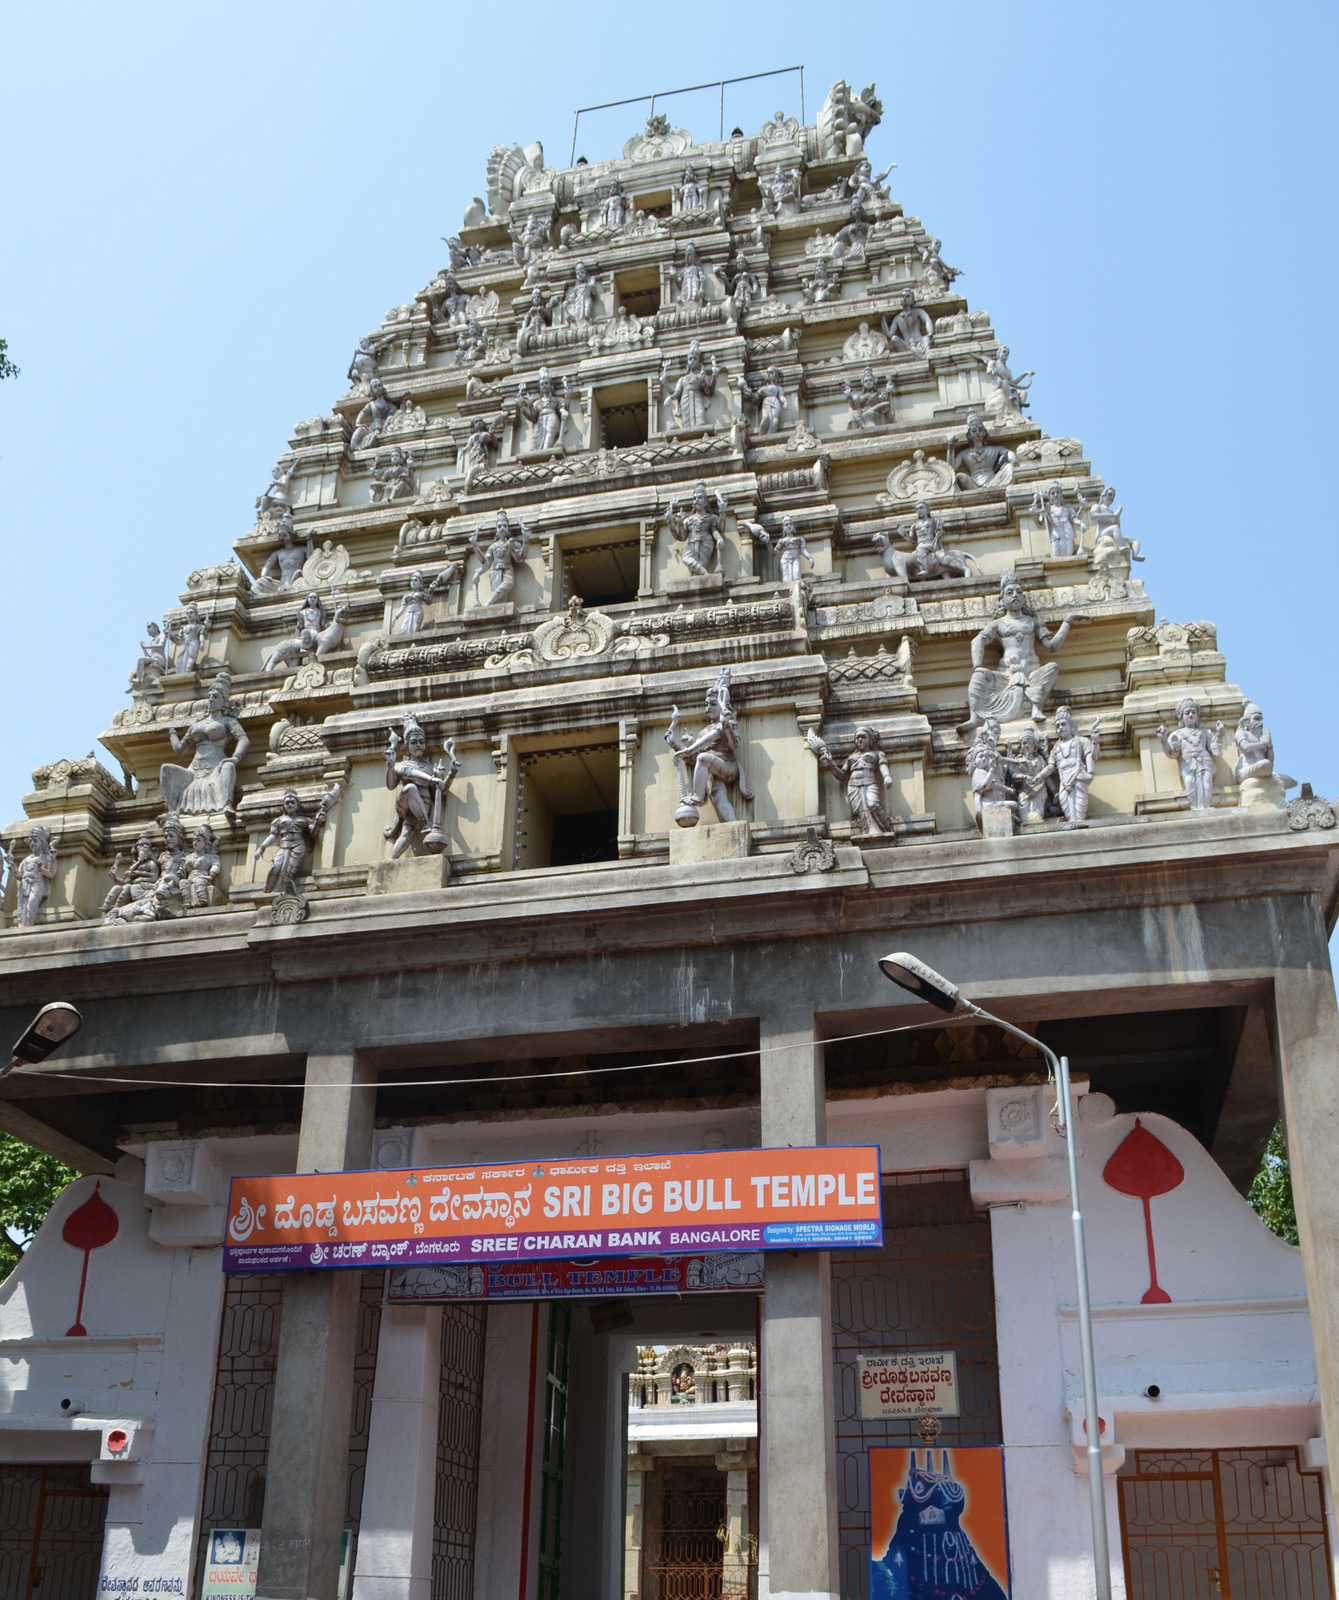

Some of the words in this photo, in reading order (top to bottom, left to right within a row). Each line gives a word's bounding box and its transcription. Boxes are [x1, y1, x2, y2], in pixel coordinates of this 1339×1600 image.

[423, 1170, 476, 1183] ಕರ್ನಾಟಕ
[482, 1167, 526, 1180] ಸರ್ಕಾರ
[549, 1163, 599, 1177] ಧಾರ್ಮಿಕ
[605, 1162, 627, 1175] ದತ್ತಿ
[633, 1160, 672, 1172] ಇಲಾಖೆ
[543, 1185, 592, 1218] SRI
[601, 1182, 653, 1215] BIG
[663, 1178, 742, 1213] BULL
[750, 1172, 876, 1209] TEMPLE
[229, 1197, 267, 1242] ಶ್ರೀ
[274, 1194, 338, 1238] ದೊಡ್ಡ
[343, 1191, 425, 1235] ಬಸವಣ್ಣ
[429, 1183, 532, 1229] ದೇವಸ್ಥಾನ
[795, 1225, 824, 1233] SPECTRA
[824, 1224, 852, 1232] SIGNAGE
[853, 1223, 876, 1232] WORLD
[470, 1238, 518, 1253] SREE
[524, 1234, 602, 1251] CHARAN
[608, 1231, 662, 1248] BANK
[670, 1229, 760, 1245] BANGALORE
[310, 1243, 329, 1264] ಶ್ರೀ
[332, 1242, 368, 1259] ಚರಣ್
[416, 1241, 461, 1255] ಬೆಂಗಳೂರು
[488, 1272, 559, 1288] BULL
[566, 1268, 681, 1285] TEMPLE
[880, 1385, 936, 1406] ದೇವಸ್ಥಾನ
